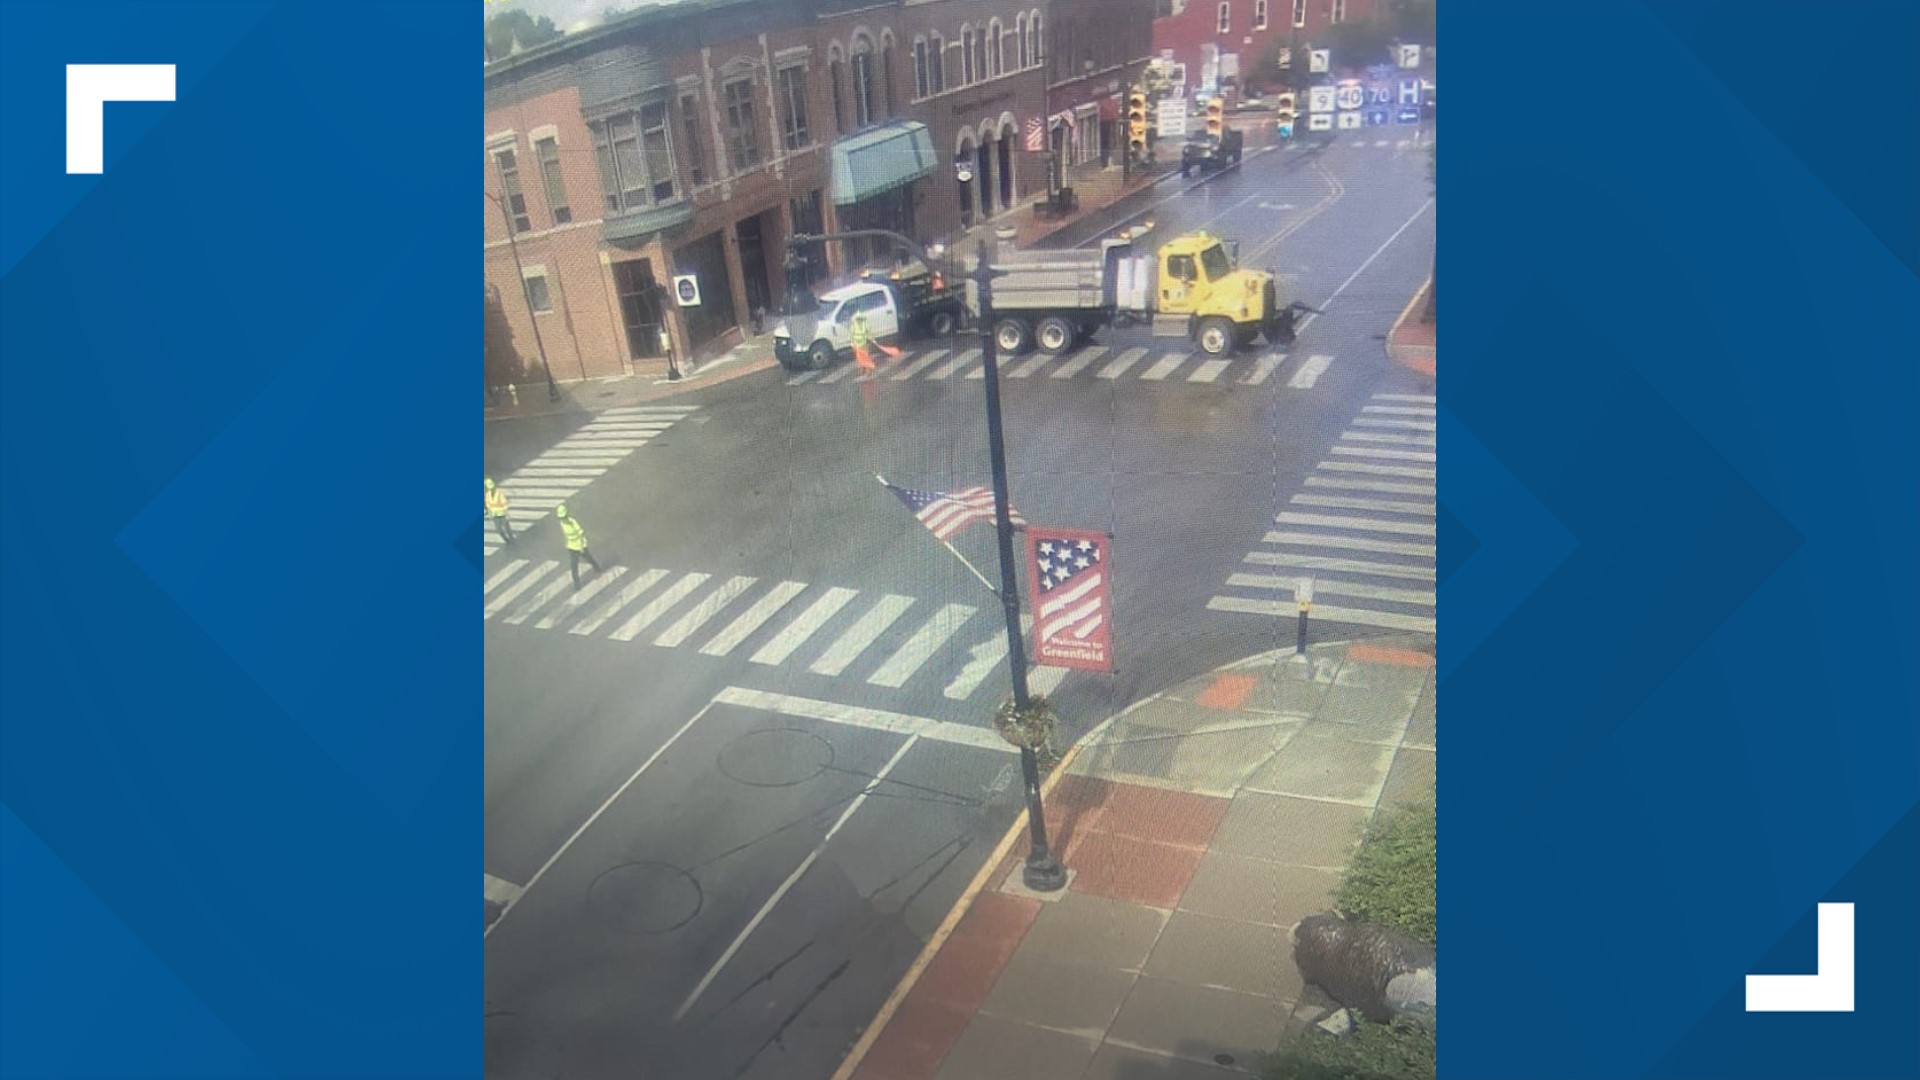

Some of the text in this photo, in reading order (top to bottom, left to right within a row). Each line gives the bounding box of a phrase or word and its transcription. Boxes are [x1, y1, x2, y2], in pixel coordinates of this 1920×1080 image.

[1341, 89, 1362, 104] 40
[1371, 89, 1389, 102] 70
[1399, 81, 1418, 104] H
[1319, 94, 1328, 109] 9
[1051, 636, 1103, 649] Welcome to
[1043, 646, 1104, 661] Greenfield
